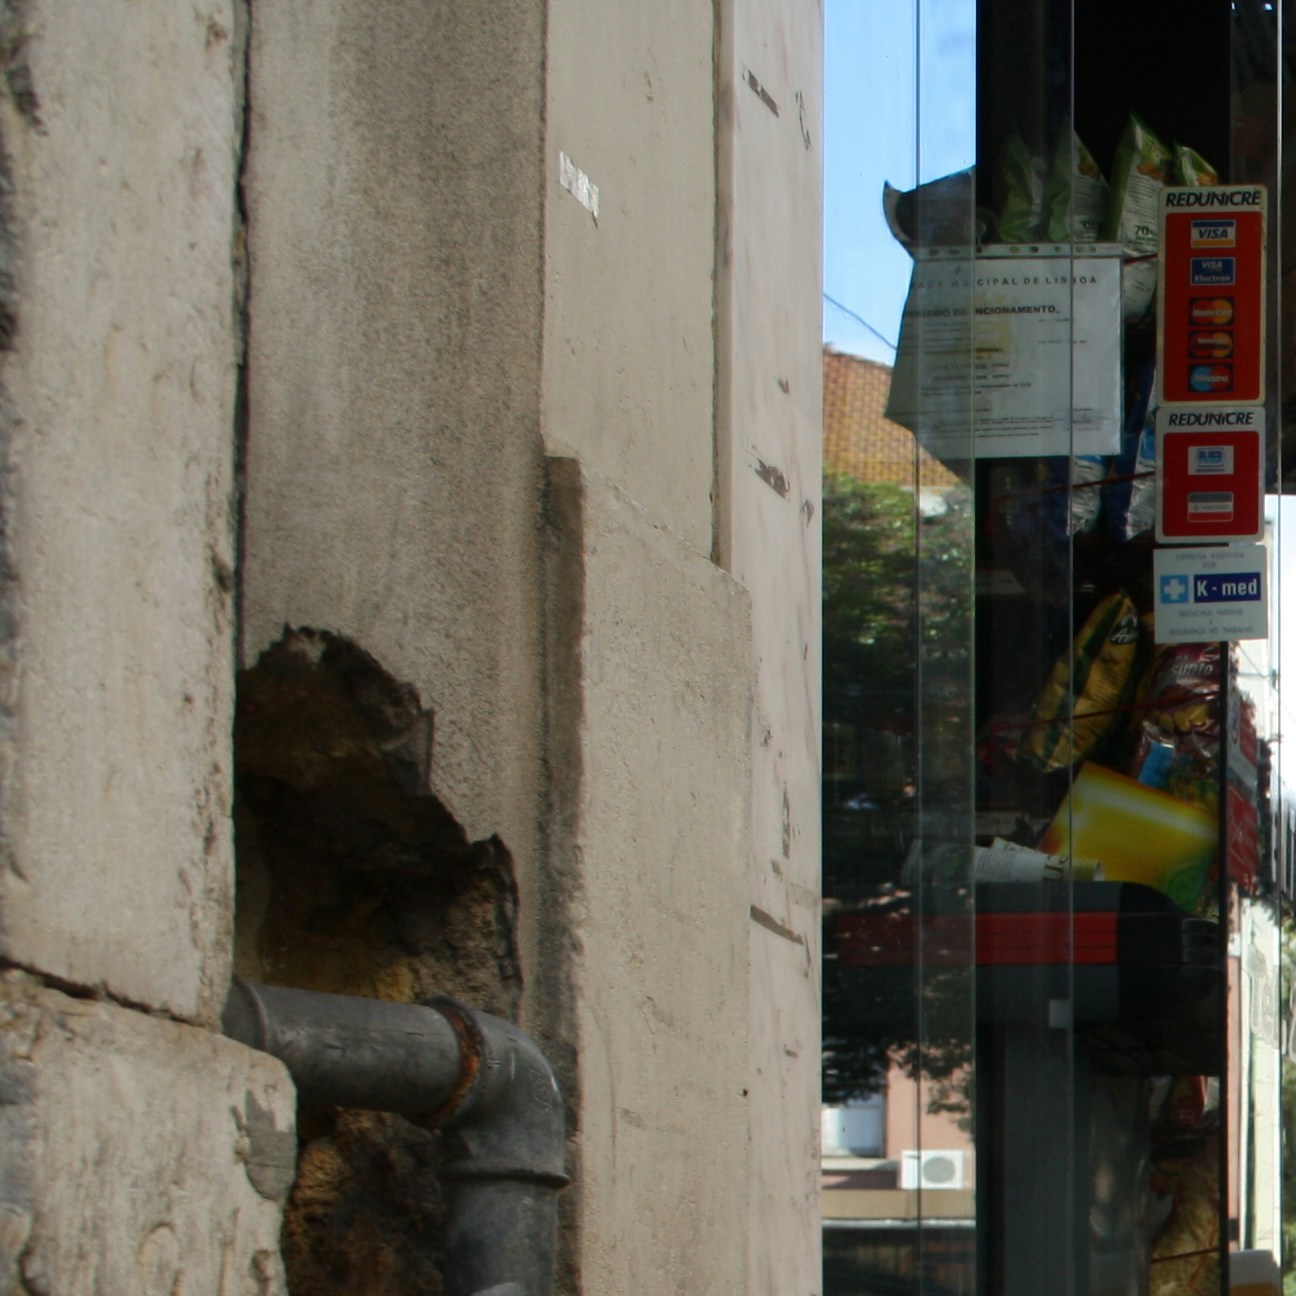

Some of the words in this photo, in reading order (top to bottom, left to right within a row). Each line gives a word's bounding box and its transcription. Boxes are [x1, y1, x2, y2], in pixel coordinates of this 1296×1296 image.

[1198, 229, 1229, 240] VISA
[1201, 261, 1223, 270] VISA
[1024, 277, 1041, 285] DE
